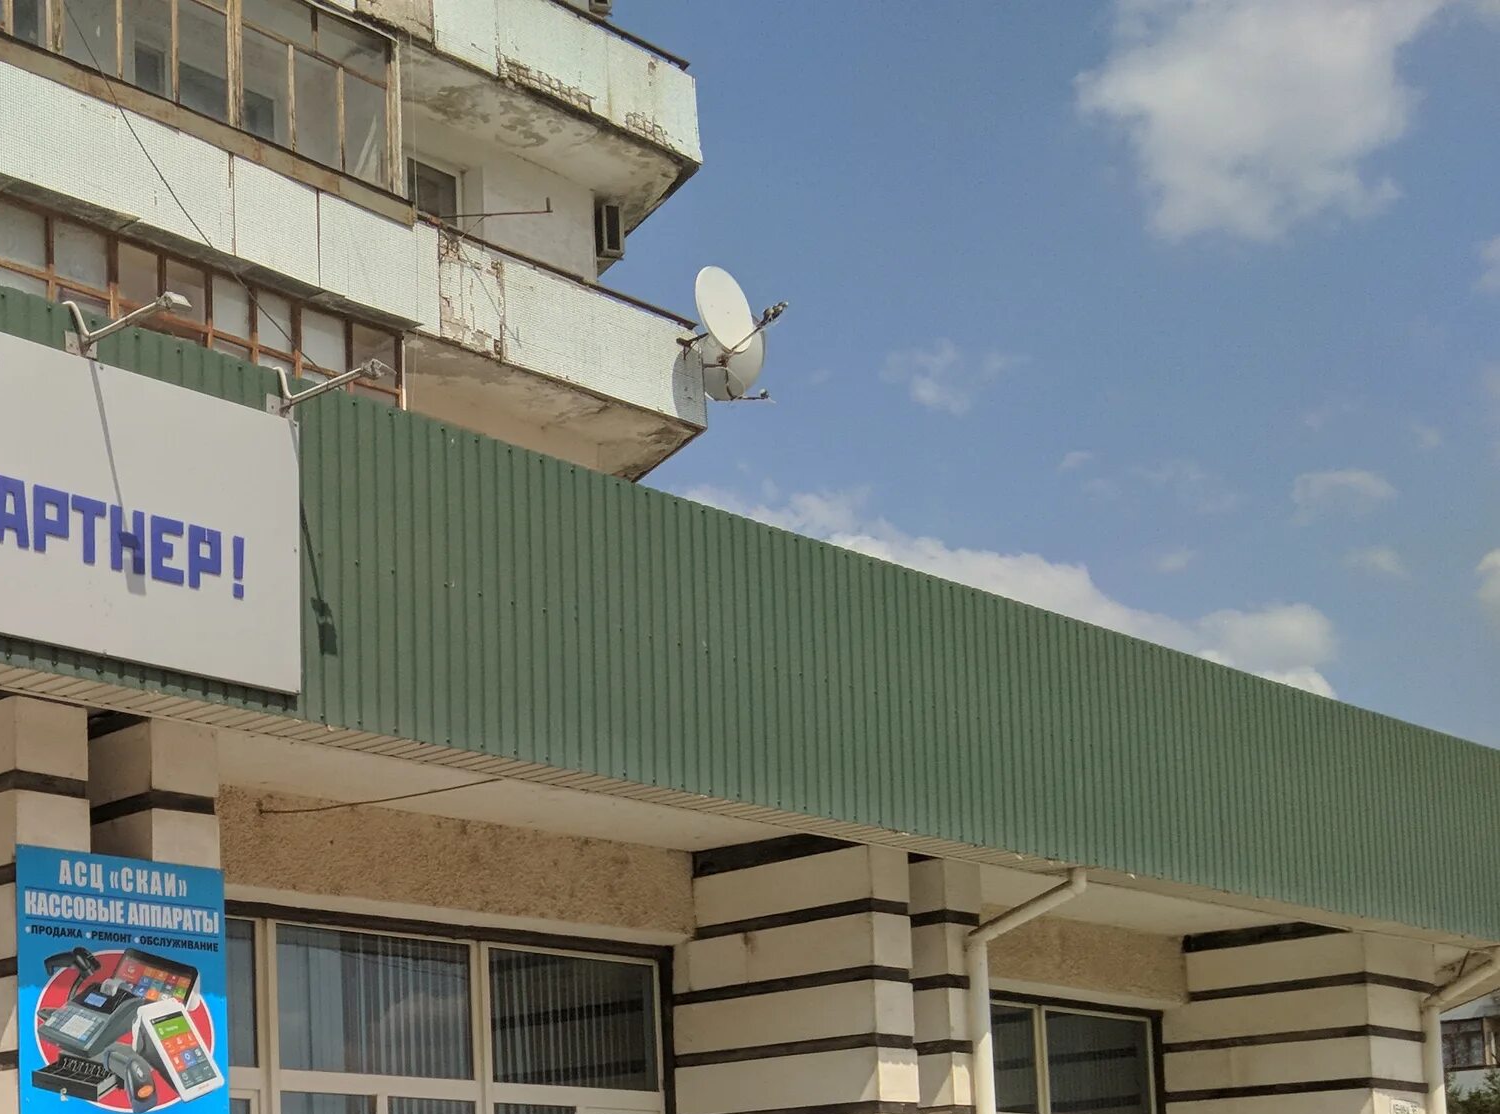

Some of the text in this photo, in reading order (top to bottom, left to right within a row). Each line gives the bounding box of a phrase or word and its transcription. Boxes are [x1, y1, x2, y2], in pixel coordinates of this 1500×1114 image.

[59, 859, 104, 893] АСЦ
[25, 890, 219, 934] КАССОВЫЕ АППАРАТЫ
[31, 925, 219, 952] ПРОДАЖА РЕМОНТ ОБСЛУЖИВАНИЕ
